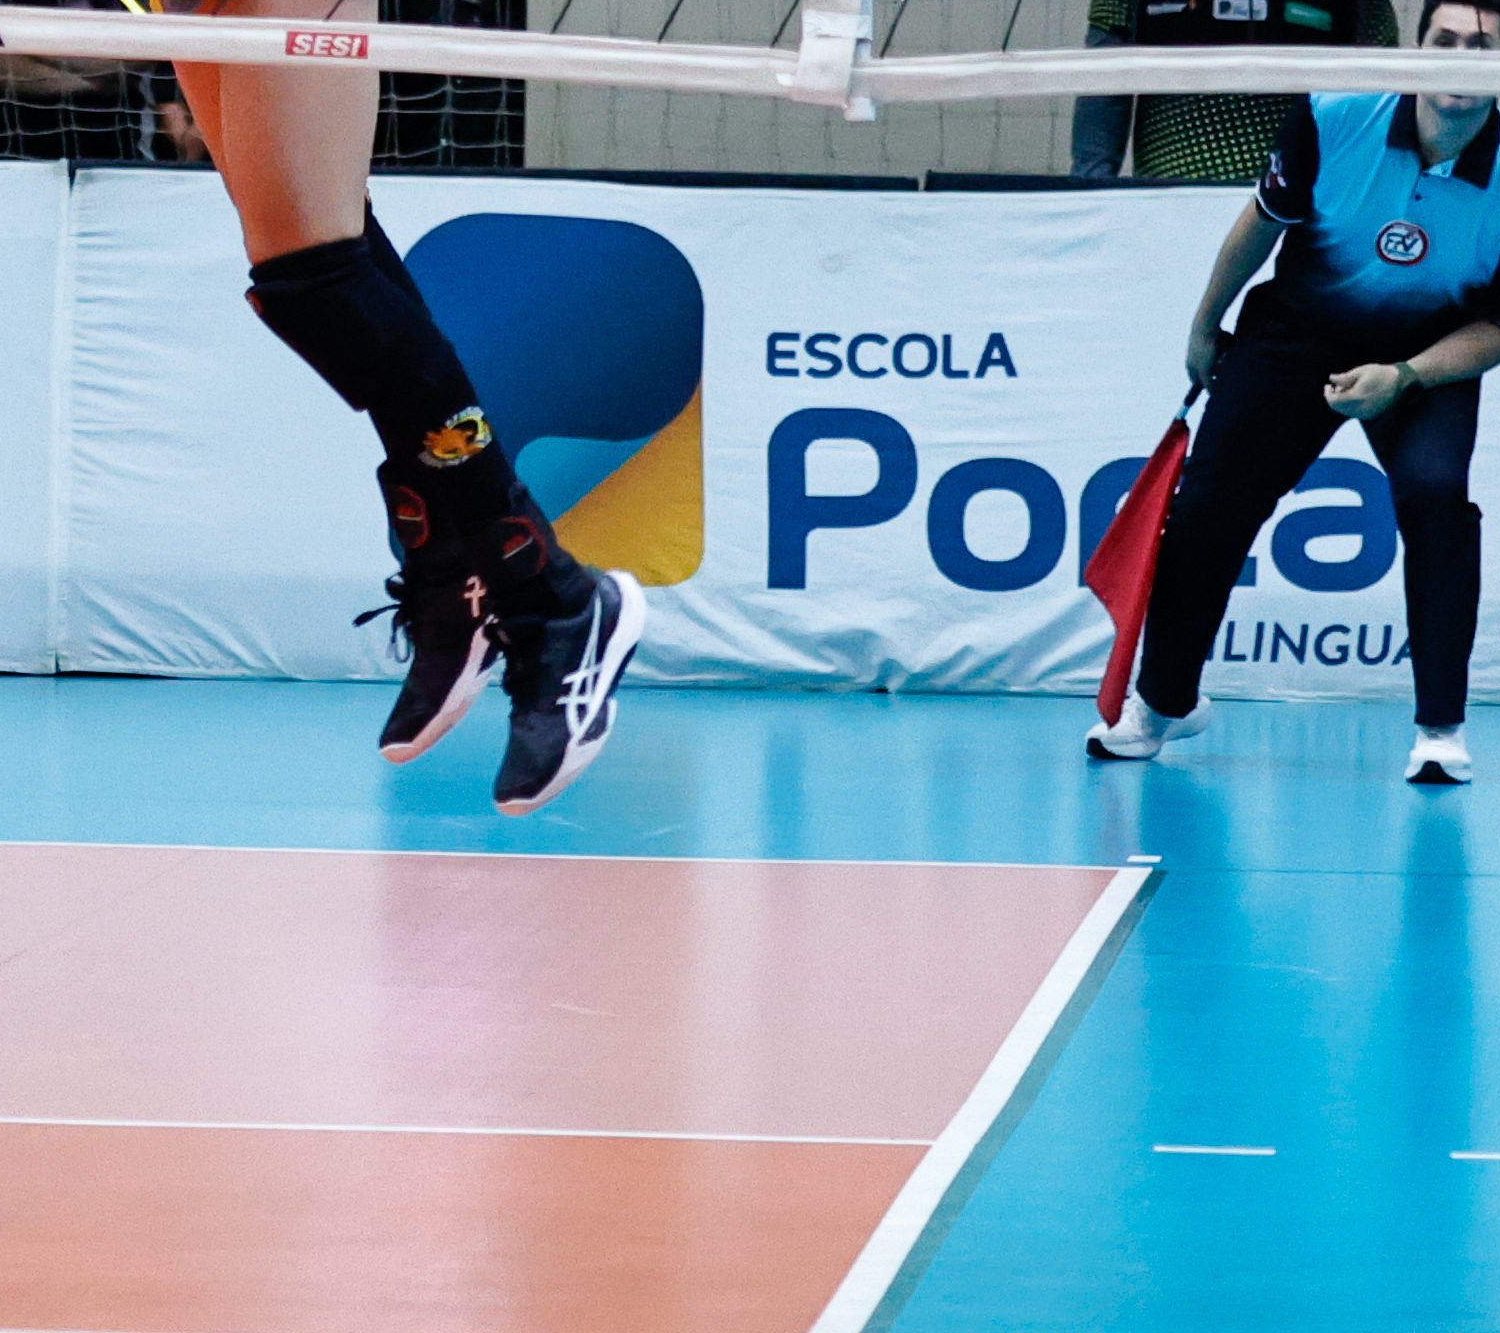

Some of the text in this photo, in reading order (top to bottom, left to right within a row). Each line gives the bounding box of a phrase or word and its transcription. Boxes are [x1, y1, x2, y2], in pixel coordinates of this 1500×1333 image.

[292, 34, 363, 57] SESI
[766, 332, 1018, 379] ESCOLA
[767, 407, 1399, 592] Poa
[1206, 620, 1412, 666] LINGU
